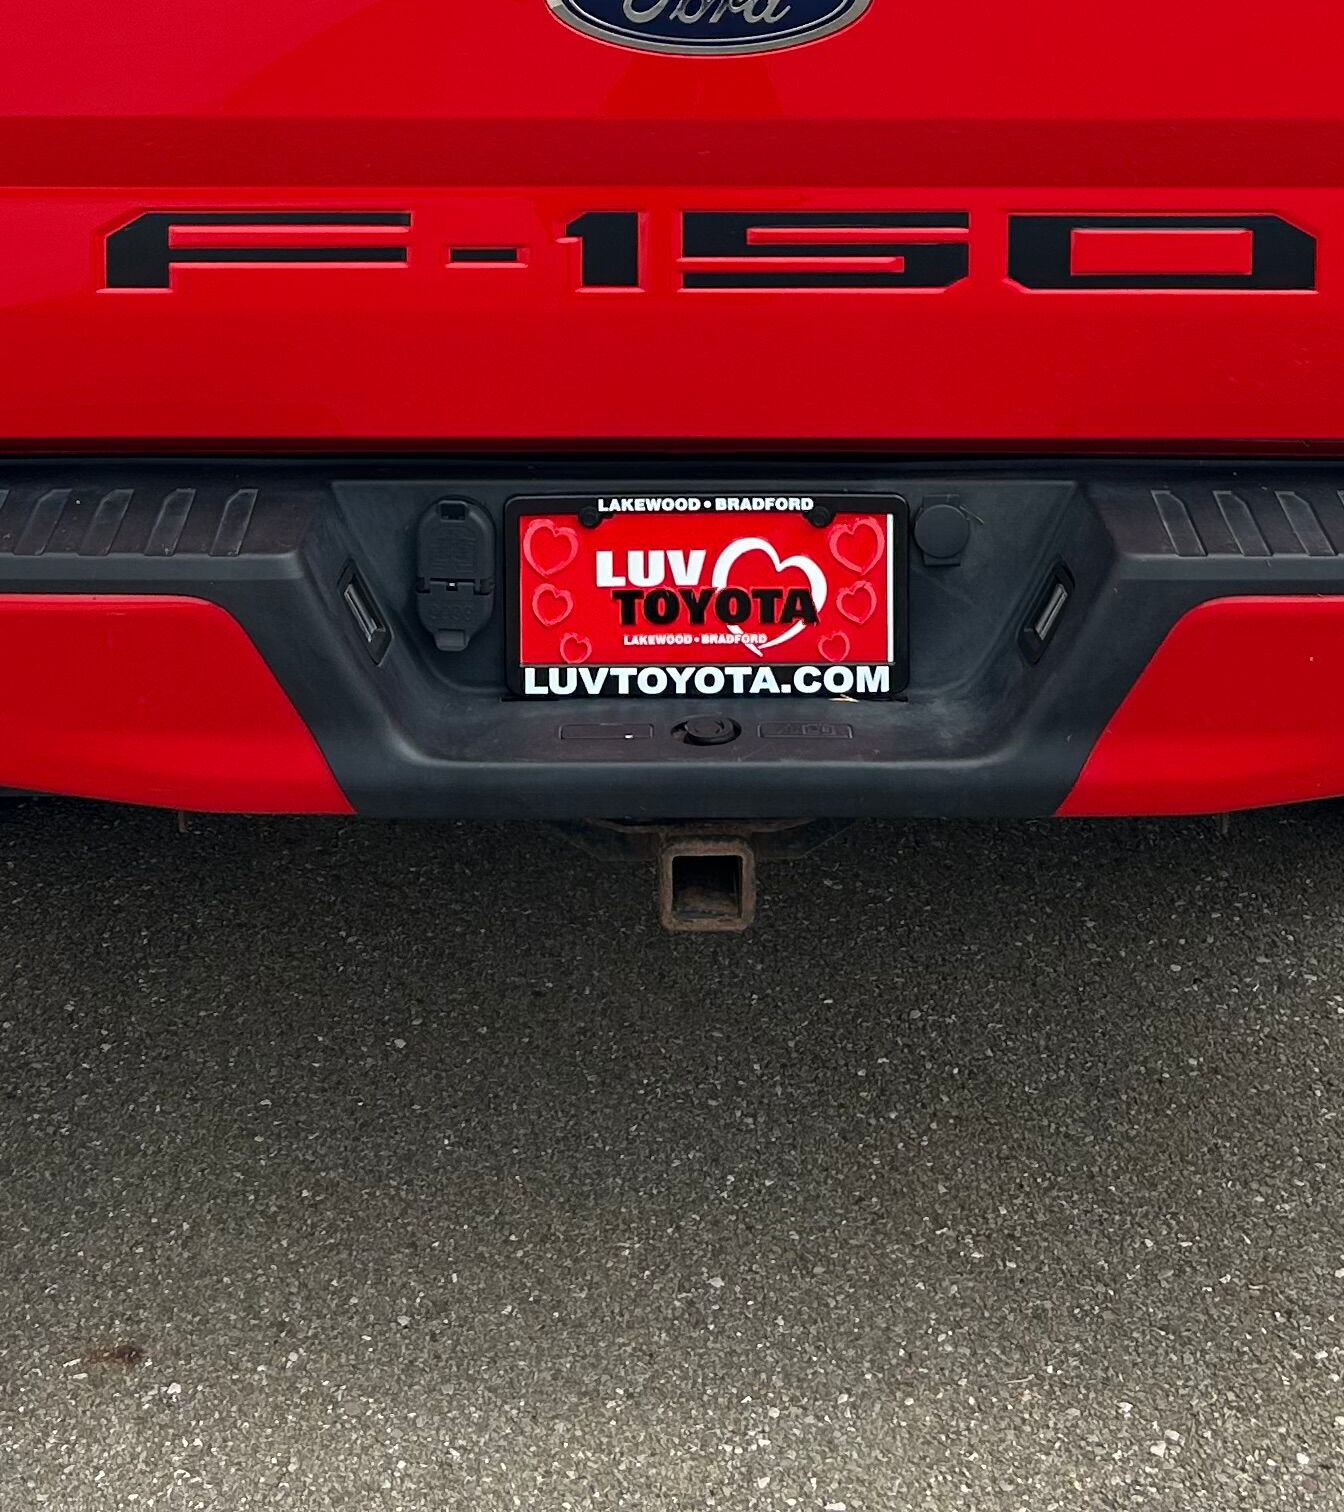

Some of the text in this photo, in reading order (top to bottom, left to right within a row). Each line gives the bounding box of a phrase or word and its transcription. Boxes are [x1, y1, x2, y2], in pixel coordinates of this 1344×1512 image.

[102, 209, 1318, 292] F-150
[598, 497, 814, 512] LAKEWOOD BRADFORD
[595, 549, 706, 587] LUV
[612, 588, 819, 626] TOYOTA
[623, 634, 768, 646] LAKEWOOD BRADFORD
[524, 665, 890, 695] LUVTOYOTA.COM
